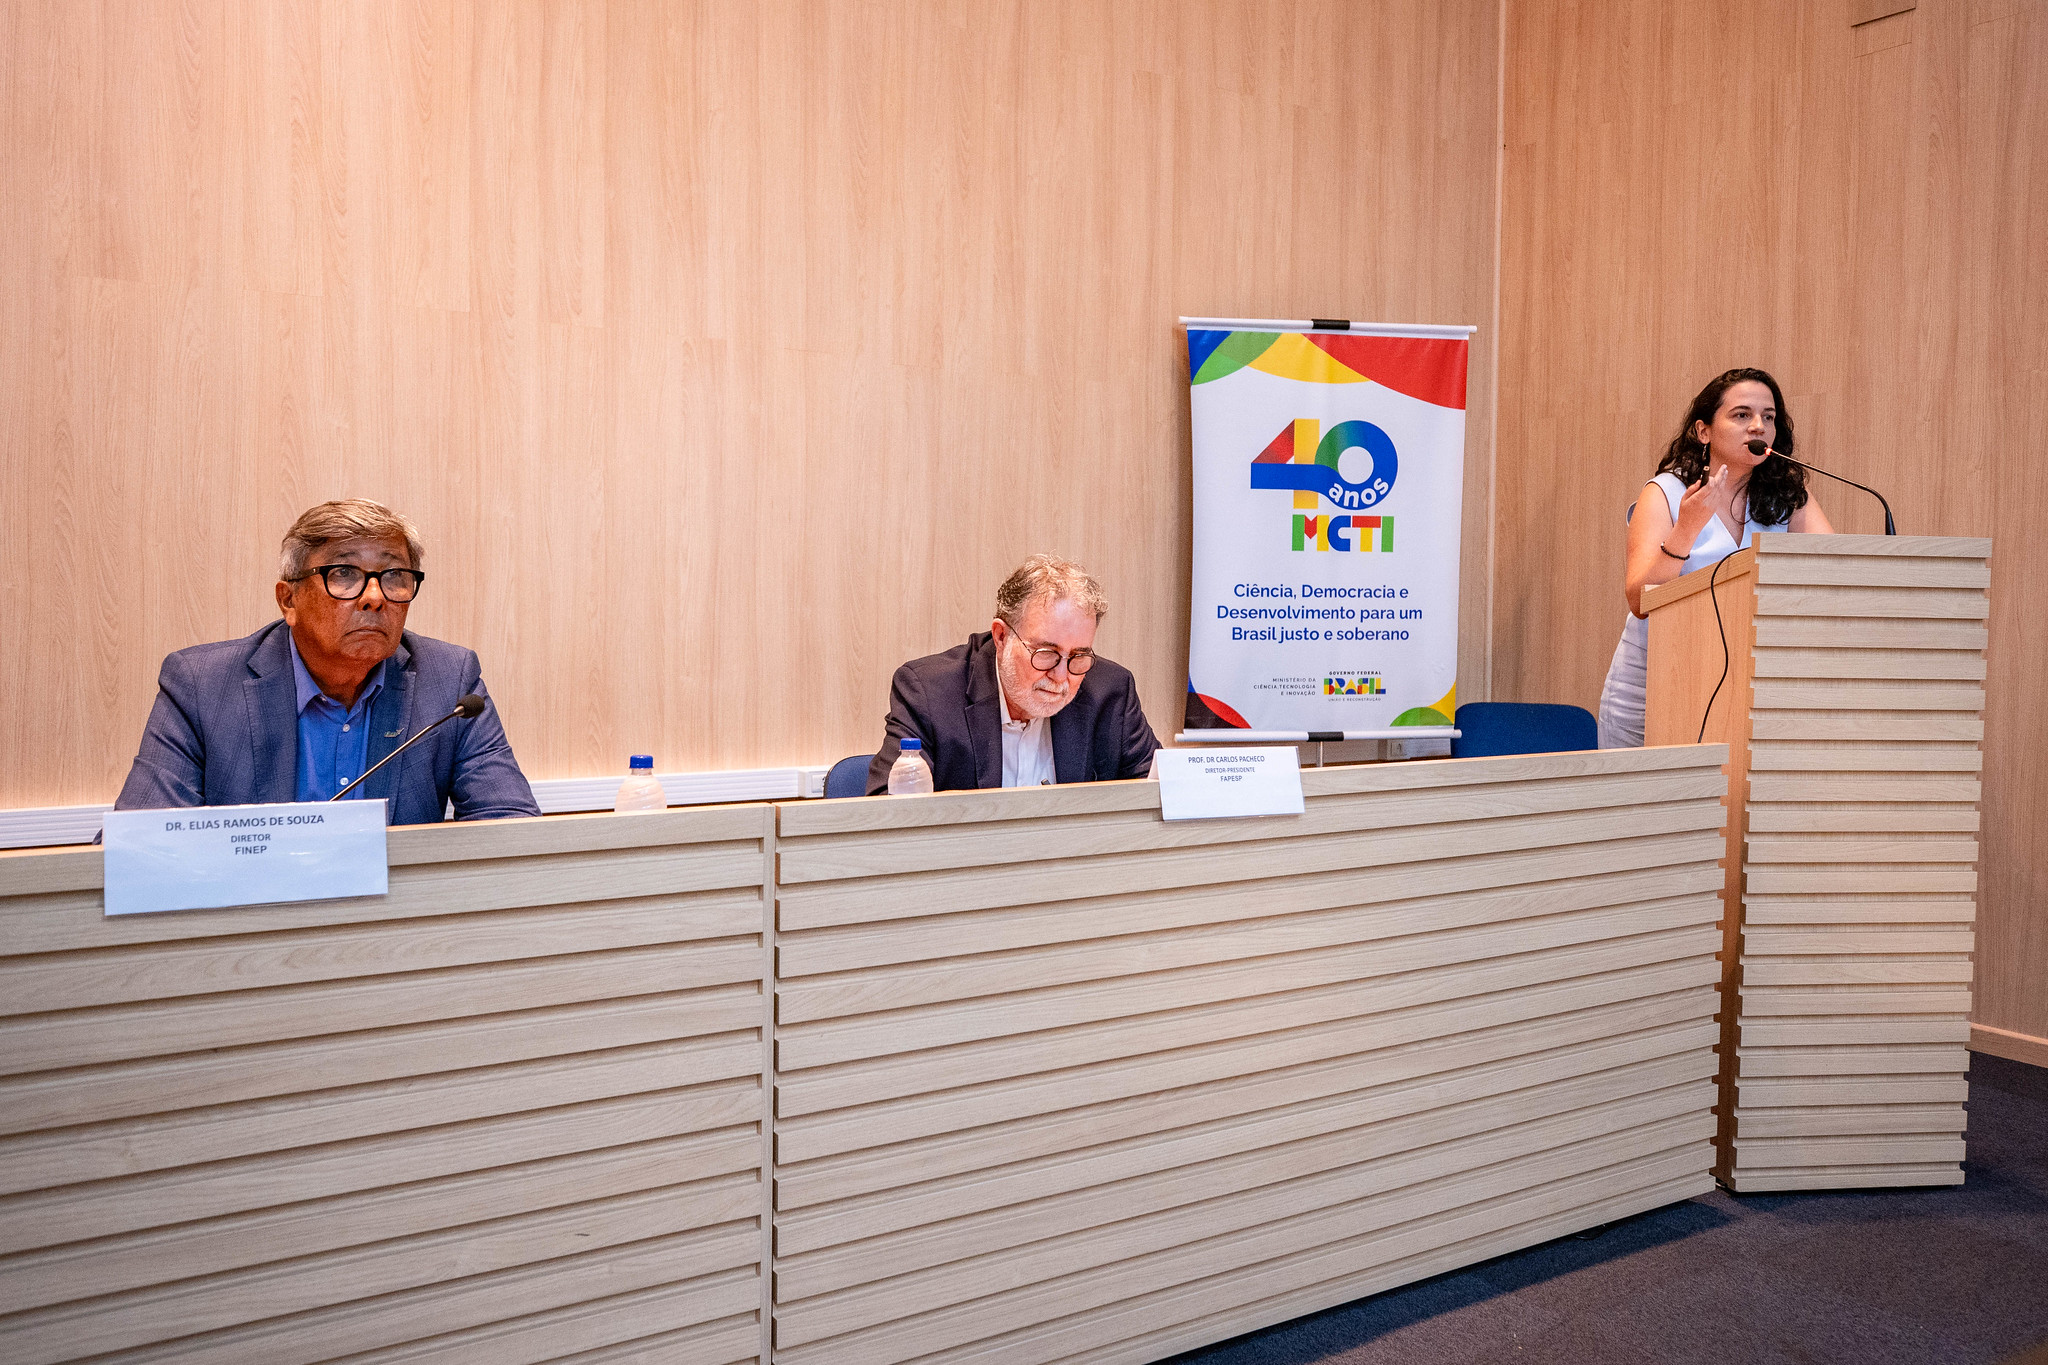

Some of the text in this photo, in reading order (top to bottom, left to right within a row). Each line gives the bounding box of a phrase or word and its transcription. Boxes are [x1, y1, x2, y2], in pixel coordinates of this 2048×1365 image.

[1328, 477, 1389, 508] anos
[1291, 514, 1395, 553] MCTI
[1233, 583, 1409, 600] Ciência, Democracia e
[1216, 605, 1423, 623] Desenvolvimento para um
[1231, 626, 1410, 644] Brasil justo e soberano
[1323, 677, 1387, 695] BRASIL
[1188, 756, 1206, 764] PROF.
[165, 814, 325, 832] DR. ELIAS RAMOS DE SOUZA
[230, 832, 272, 844] DIRETOR
[234, 844, 268, 856] FINEP
